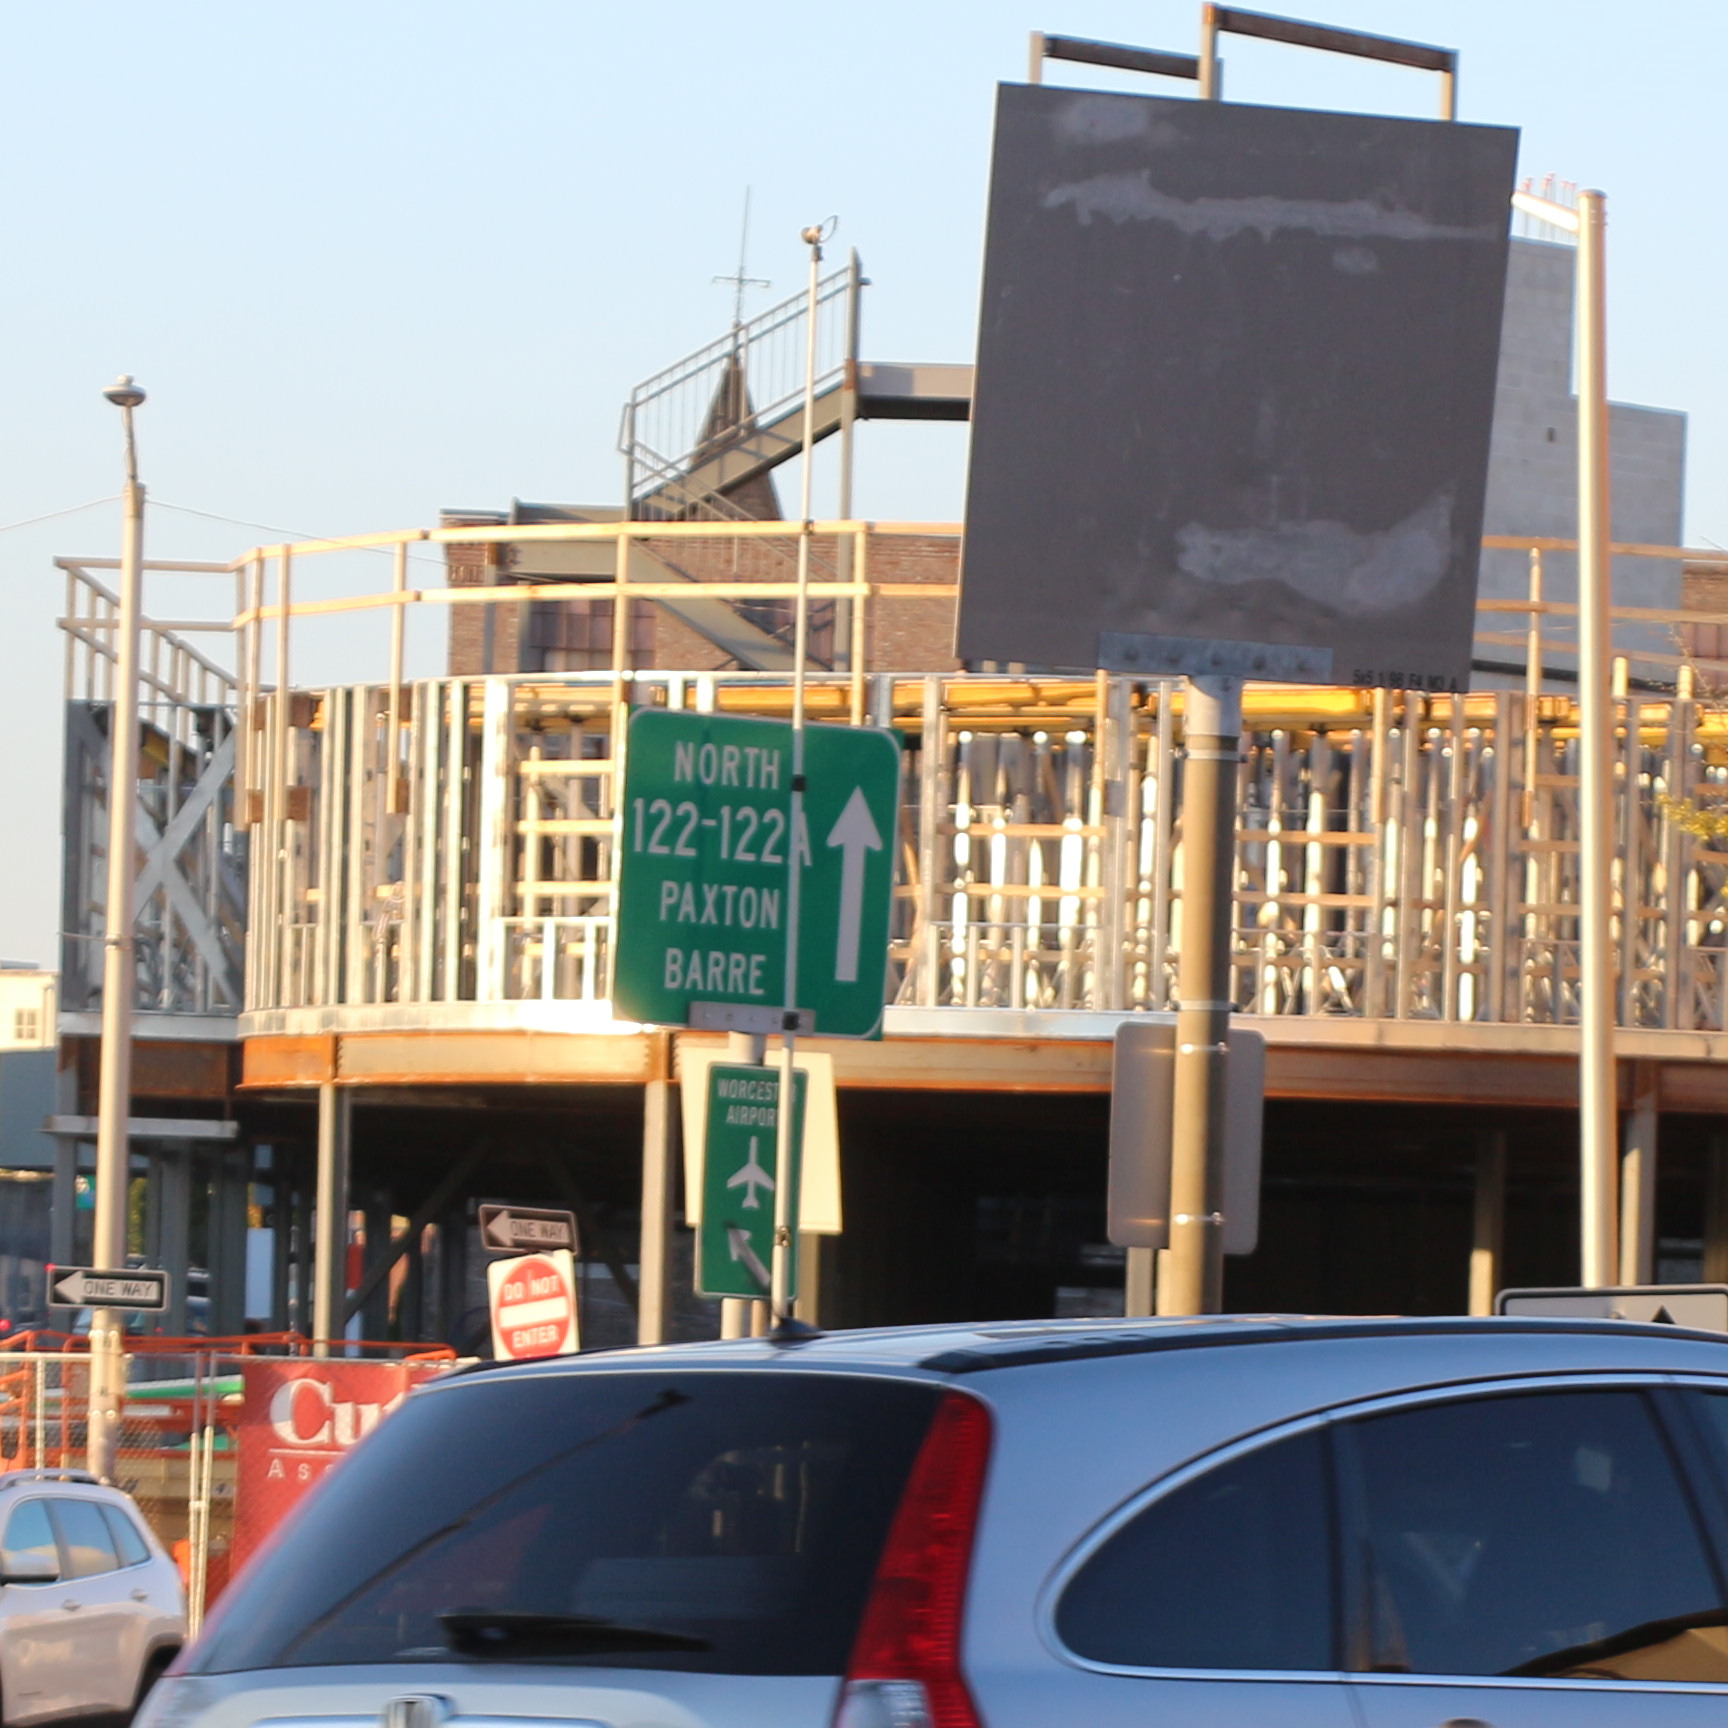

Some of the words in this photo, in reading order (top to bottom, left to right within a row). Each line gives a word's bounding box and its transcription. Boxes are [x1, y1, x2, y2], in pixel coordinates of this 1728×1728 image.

[674, 741, 780, 790] NORTH
[633, 797, 813, 868] 122-122A
[659, 880, 780, 930] PAXTON
[663, 947, 766, 996] BARRE
[718, 1078, 799, 1103] WORCESTR
[725, 1105, 780, 1127] AIRPOR
[512, 1220, 535, 1237] ONE
[540, 1223, 564, 1239] WAY
[83, 1280, 114, 1296] ONE
[122, 1281, 153, 1297] WAY
[503, 1281, 525, 1301] DO
[530, 1274, 560, 1297] NOT
[512, 1324, 560, 1349] ENTER
[268, 1376, 407, 1448] Cu
